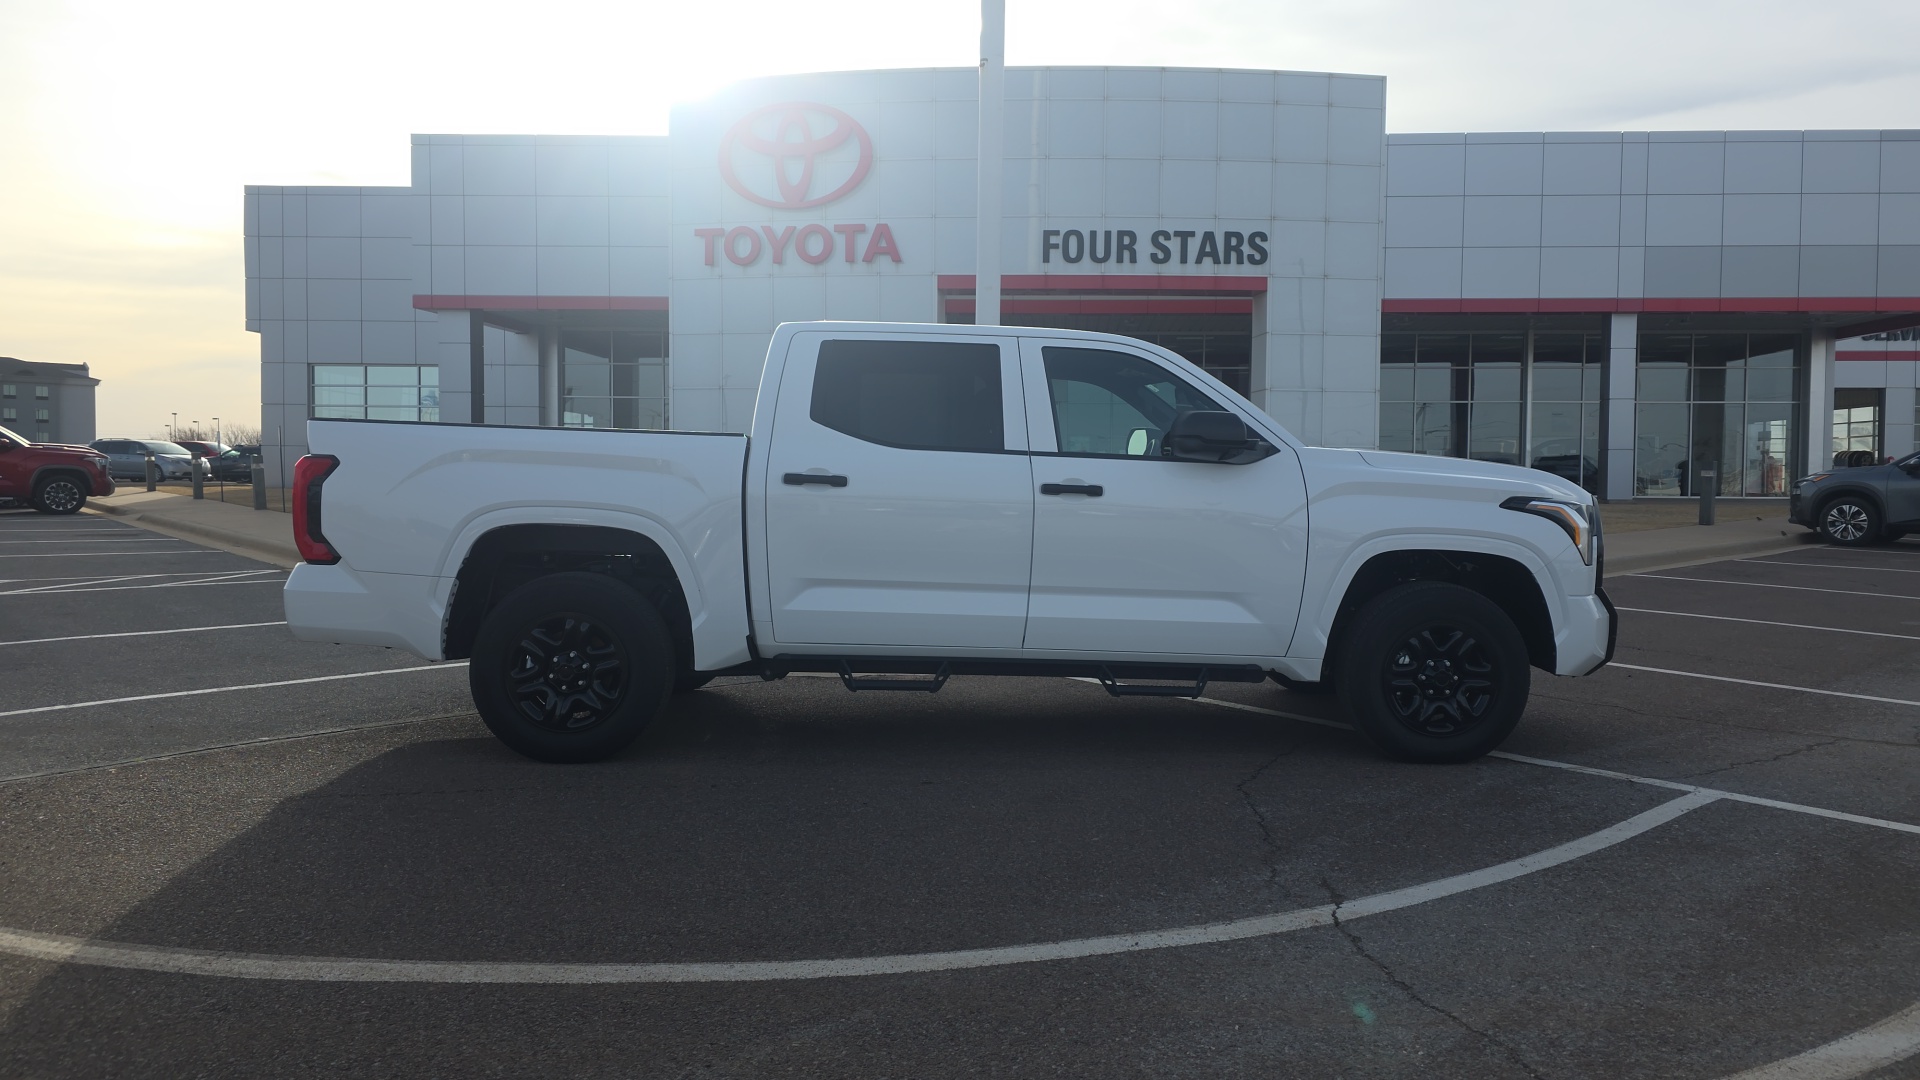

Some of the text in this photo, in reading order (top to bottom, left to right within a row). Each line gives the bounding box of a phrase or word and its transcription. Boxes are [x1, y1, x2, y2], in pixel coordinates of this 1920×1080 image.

[694, 223, 902, 266] TOYOTA
[1042, 229, 1269, 265] FOUR STARS
